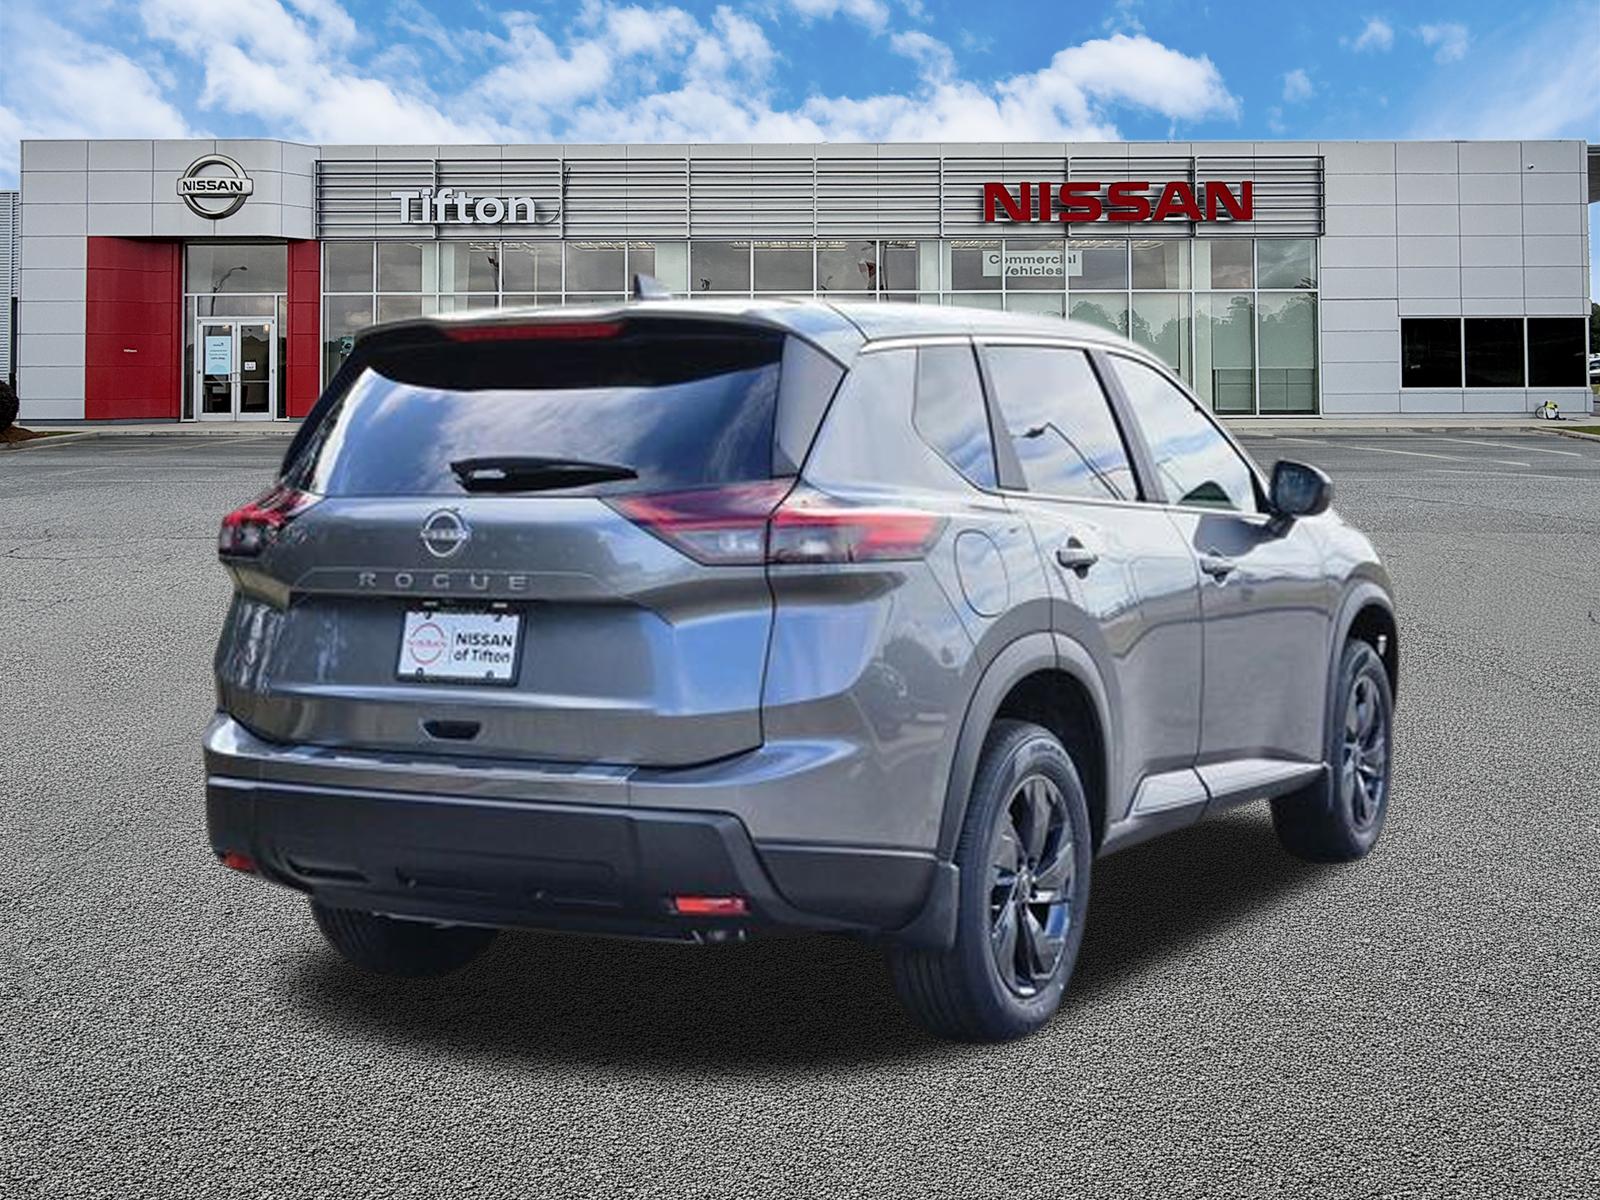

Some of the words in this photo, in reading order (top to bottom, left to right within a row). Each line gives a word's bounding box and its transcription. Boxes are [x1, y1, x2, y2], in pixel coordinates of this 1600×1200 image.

[182, 180, 243, 191] NISSAN
[390, 188, 536, 224] Tifton
[983, 181, 1253, 222] NISSAN
[358, 572, 529, 590] ROGUE
[455, 633, 513, 647] NISSAN
[453, 648, 469, 661] of
[472, 650, 510, 663] Tifton
